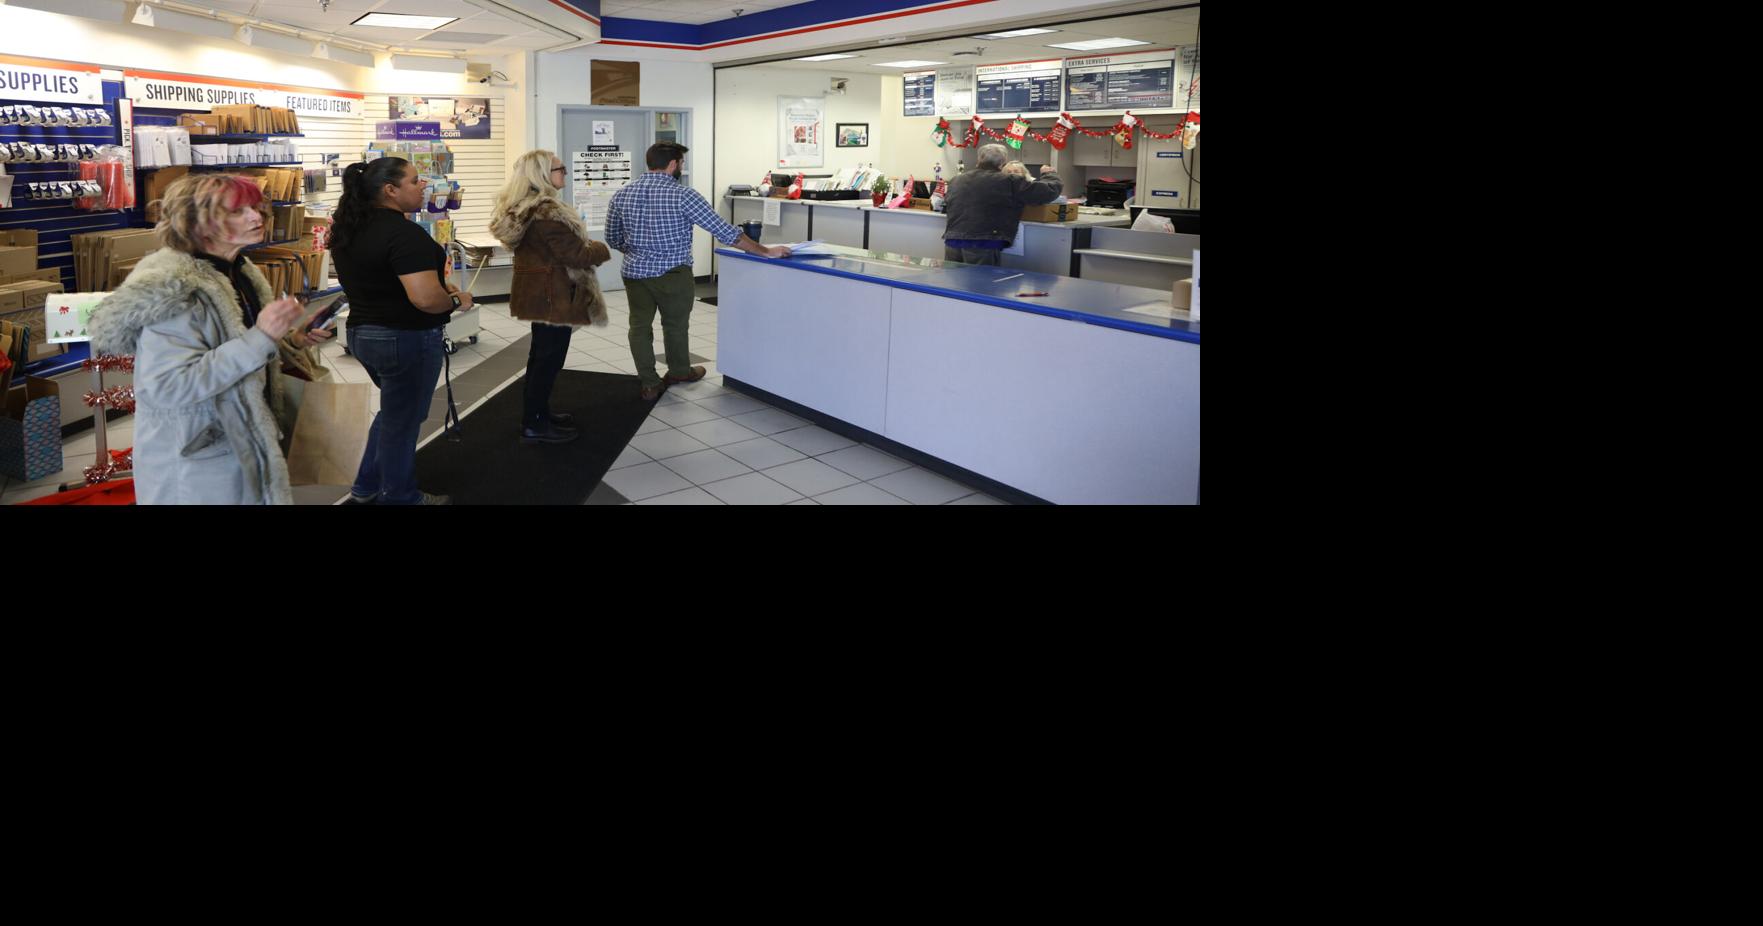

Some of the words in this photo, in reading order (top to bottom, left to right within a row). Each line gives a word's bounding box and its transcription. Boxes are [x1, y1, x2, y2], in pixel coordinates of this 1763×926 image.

[1068, 59, 1083, 67] EXTRA
[1085, 57, 1110, 65] SERVICES
[146, 83, 203, 103] SHIPPING
[286, 96, 328, 111] FEATURED
[330, 100, 351, 113] ITEMS
[400, 128, 439, 138] Hallmark
[440, 130, 460, 138] .com
